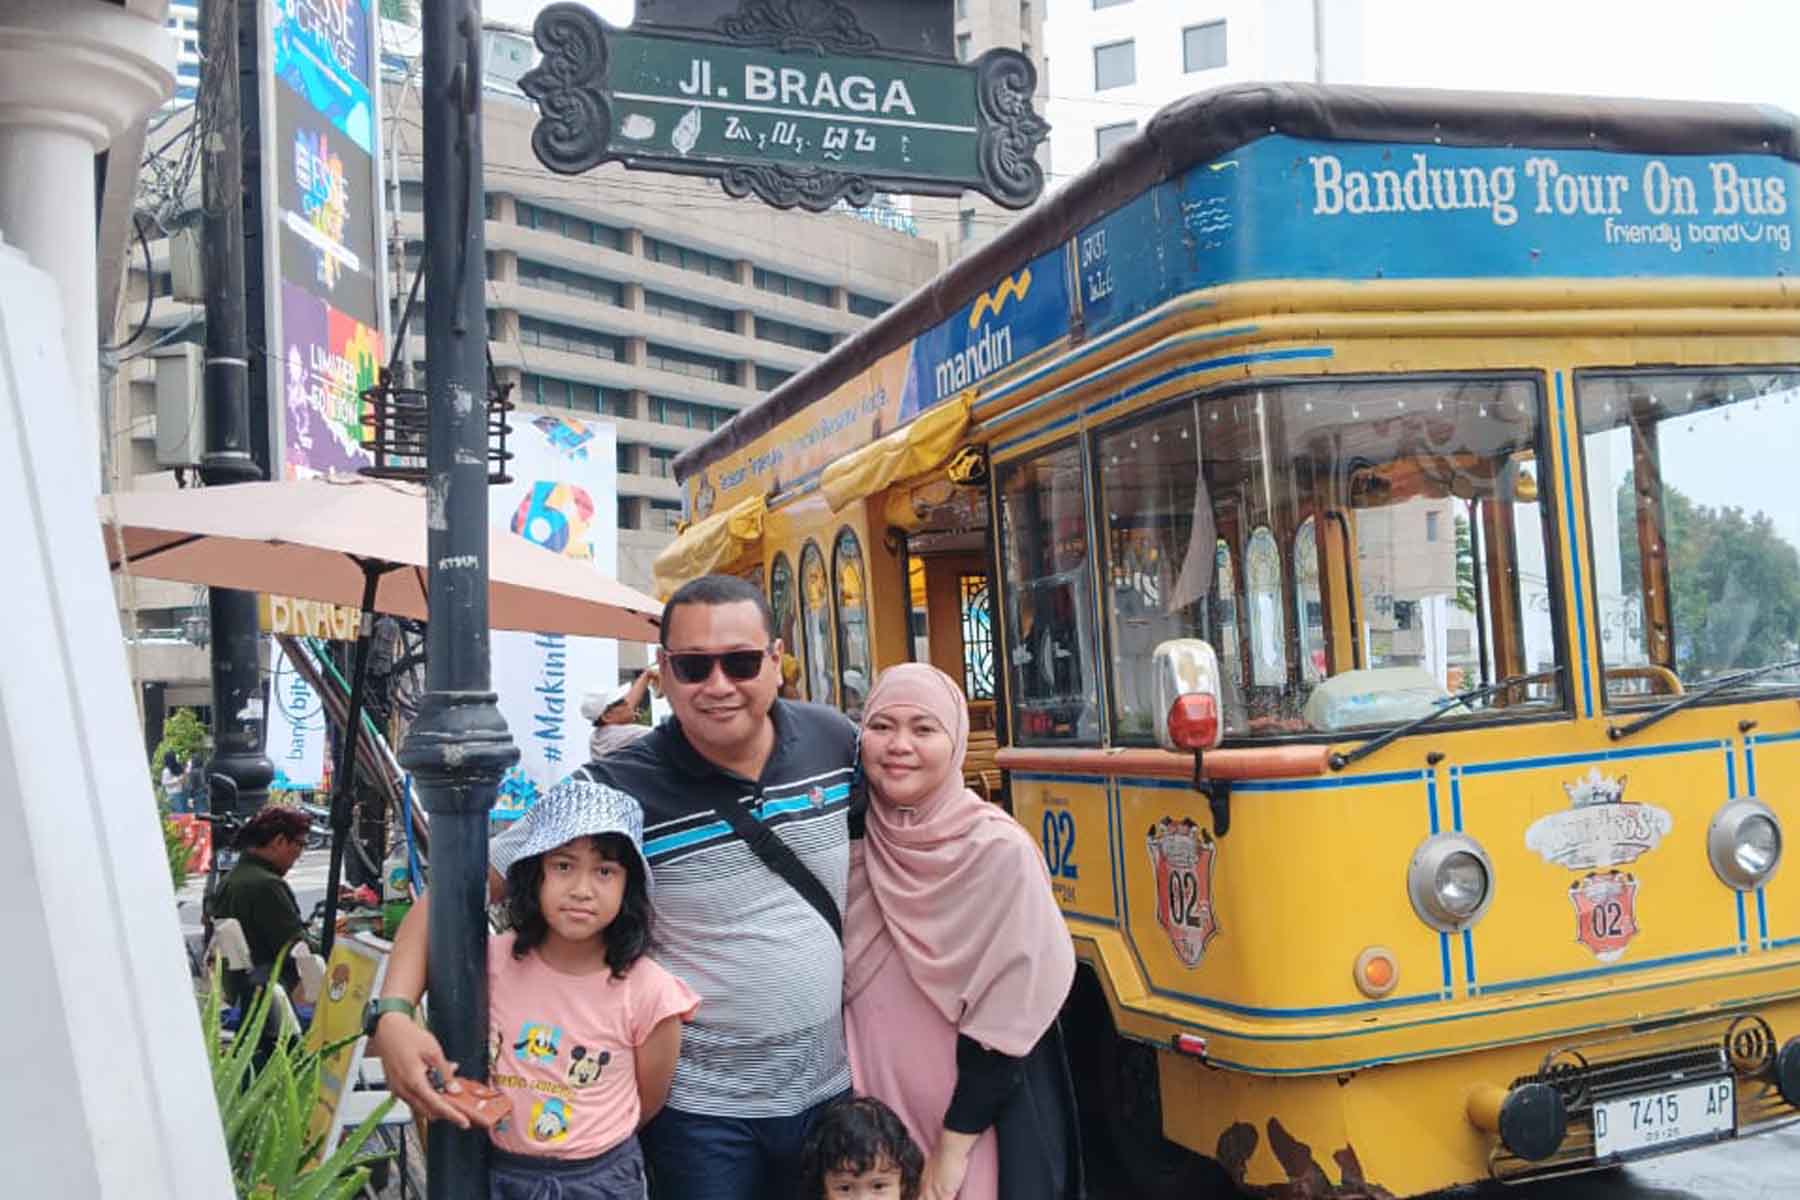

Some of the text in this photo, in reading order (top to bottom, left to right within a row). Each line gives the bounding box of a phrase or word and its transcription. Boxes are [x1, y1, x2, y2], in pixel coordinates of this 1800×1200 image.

[744, 64, 917, 116] BRAGA
[1308, 152, 1788, 227] Bandung Tour On Bus
[1043, 809, 1078, 880] 02
[1168, 869, 1201, 928] 02
[1592, 902, 1623, 938] 02
[1595, 1084, 1730, 1139] D 7415 AP
